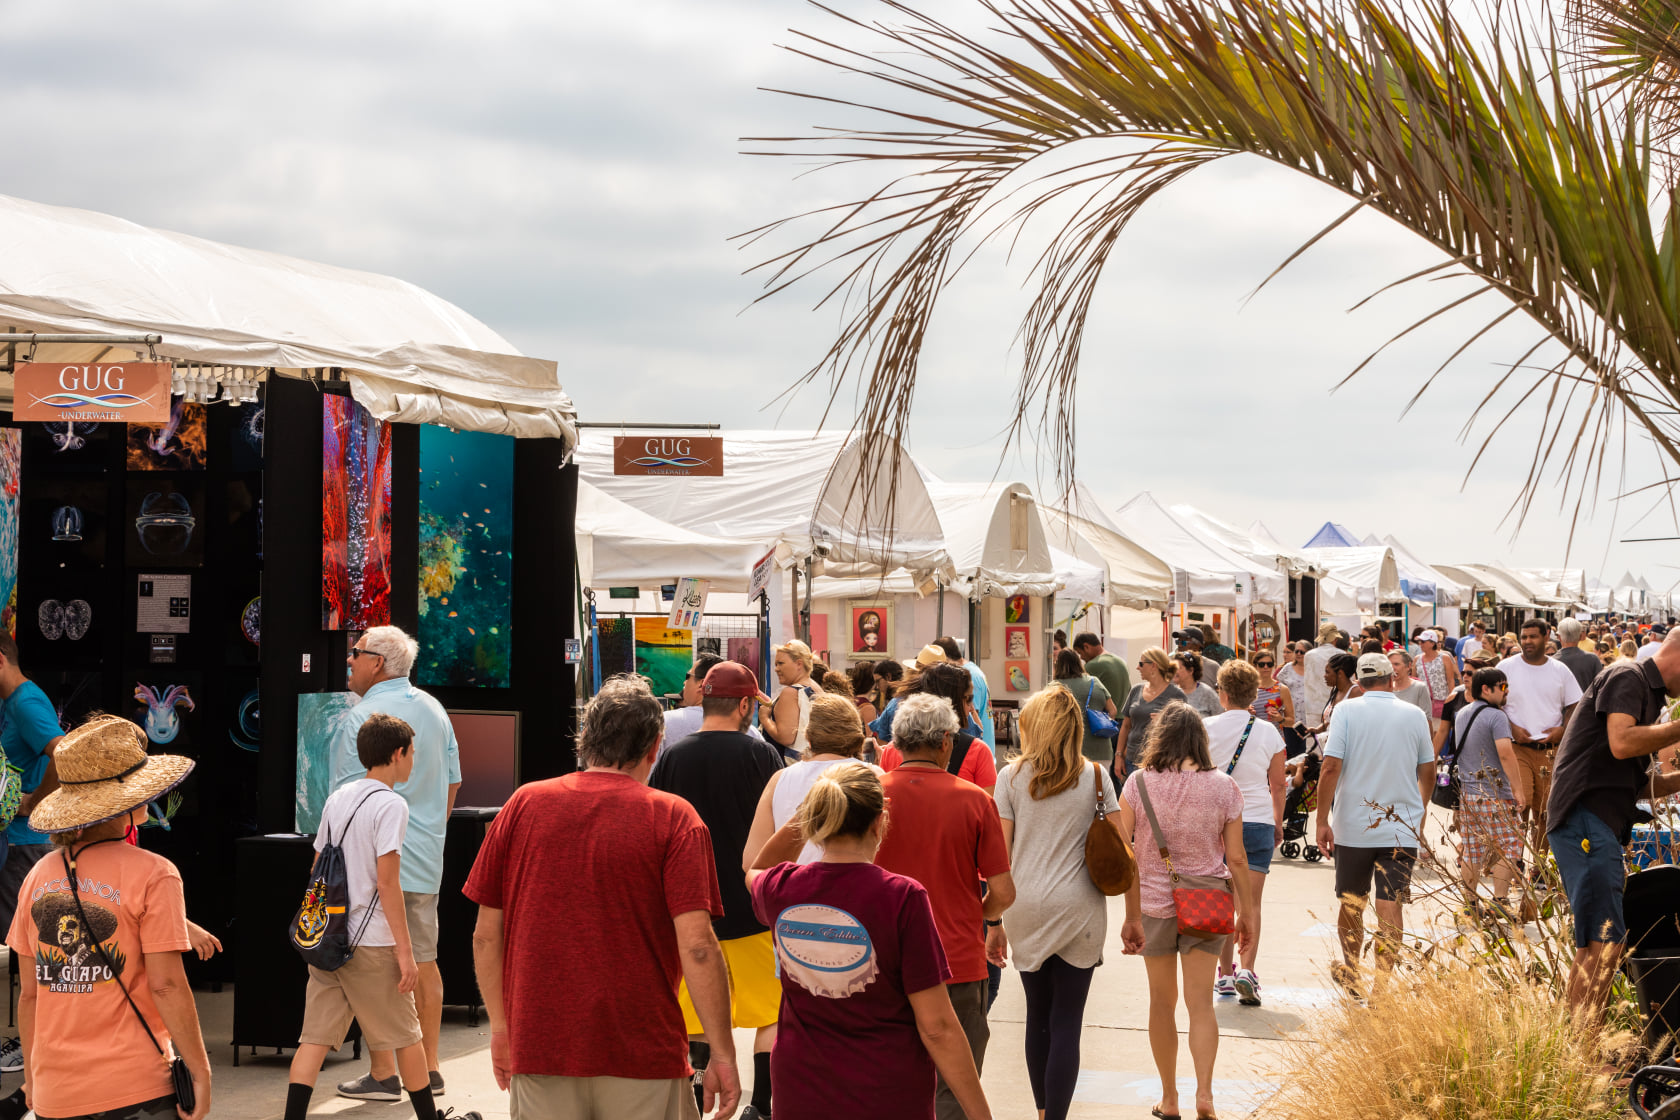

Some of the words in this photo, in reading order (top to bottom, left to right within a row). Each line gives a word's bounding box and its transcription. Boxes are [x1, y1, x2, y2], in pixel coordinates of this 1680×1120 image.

[59, 366, 125, 391] GUG
[644, 438, 691, 456] GUG
[36, 964, 53, 981] EL
